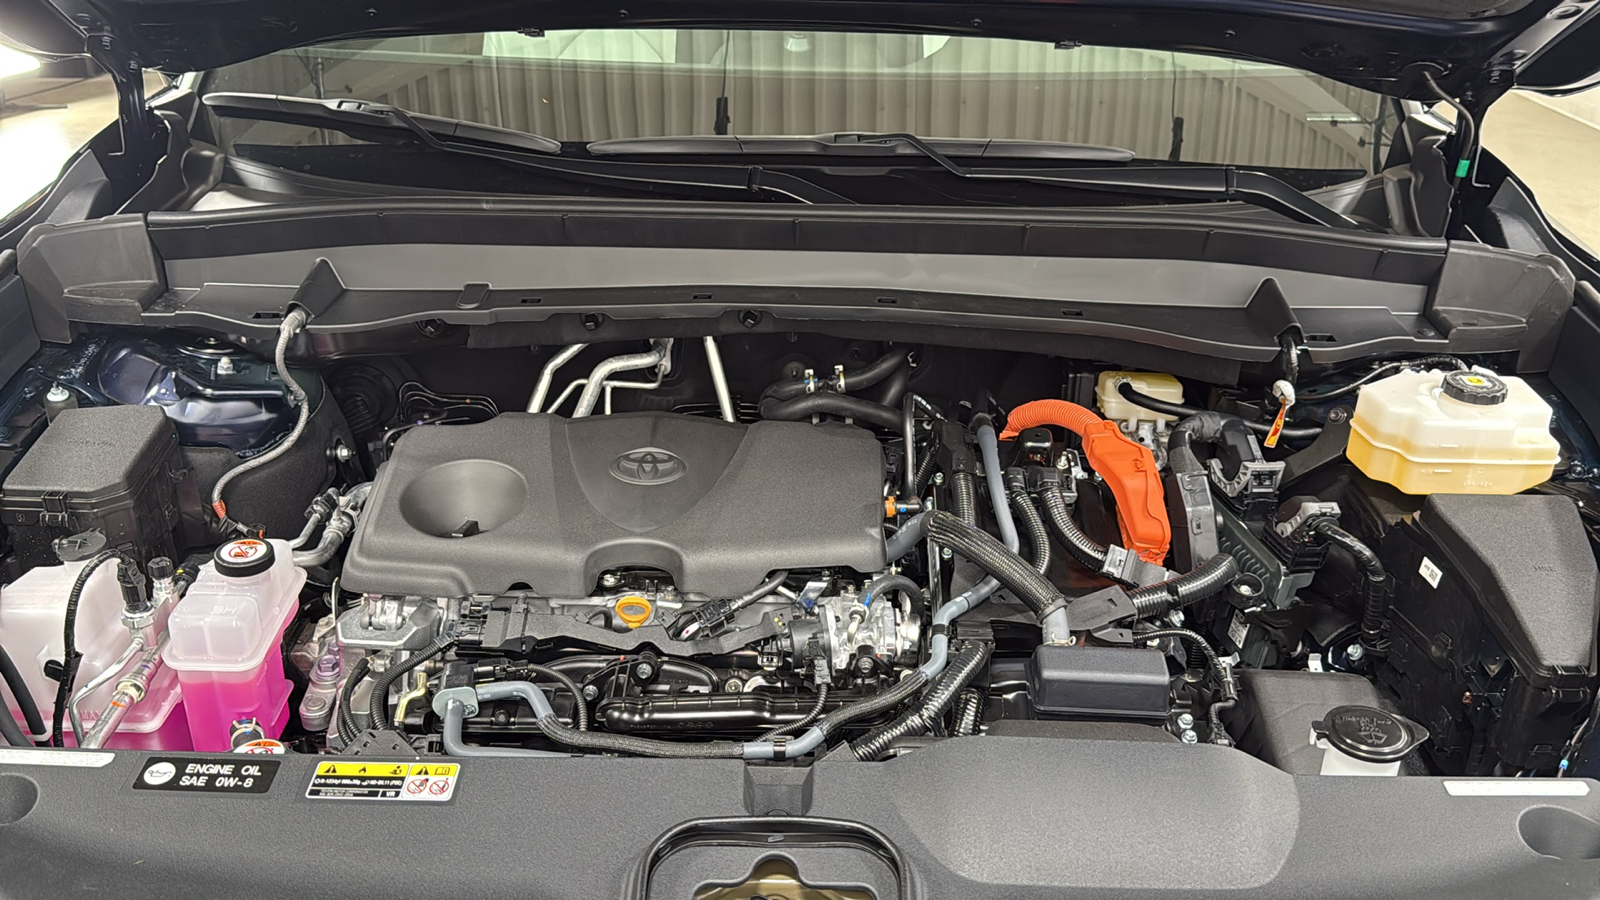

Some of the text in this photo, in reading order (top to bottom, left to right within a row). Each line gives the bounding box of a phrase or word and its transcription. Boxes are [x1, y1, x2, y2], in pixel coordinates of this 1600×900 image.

[185, 763, 262, 776] ENGINE OIL
[179, 776, 254, 788] SAE 0W-8
